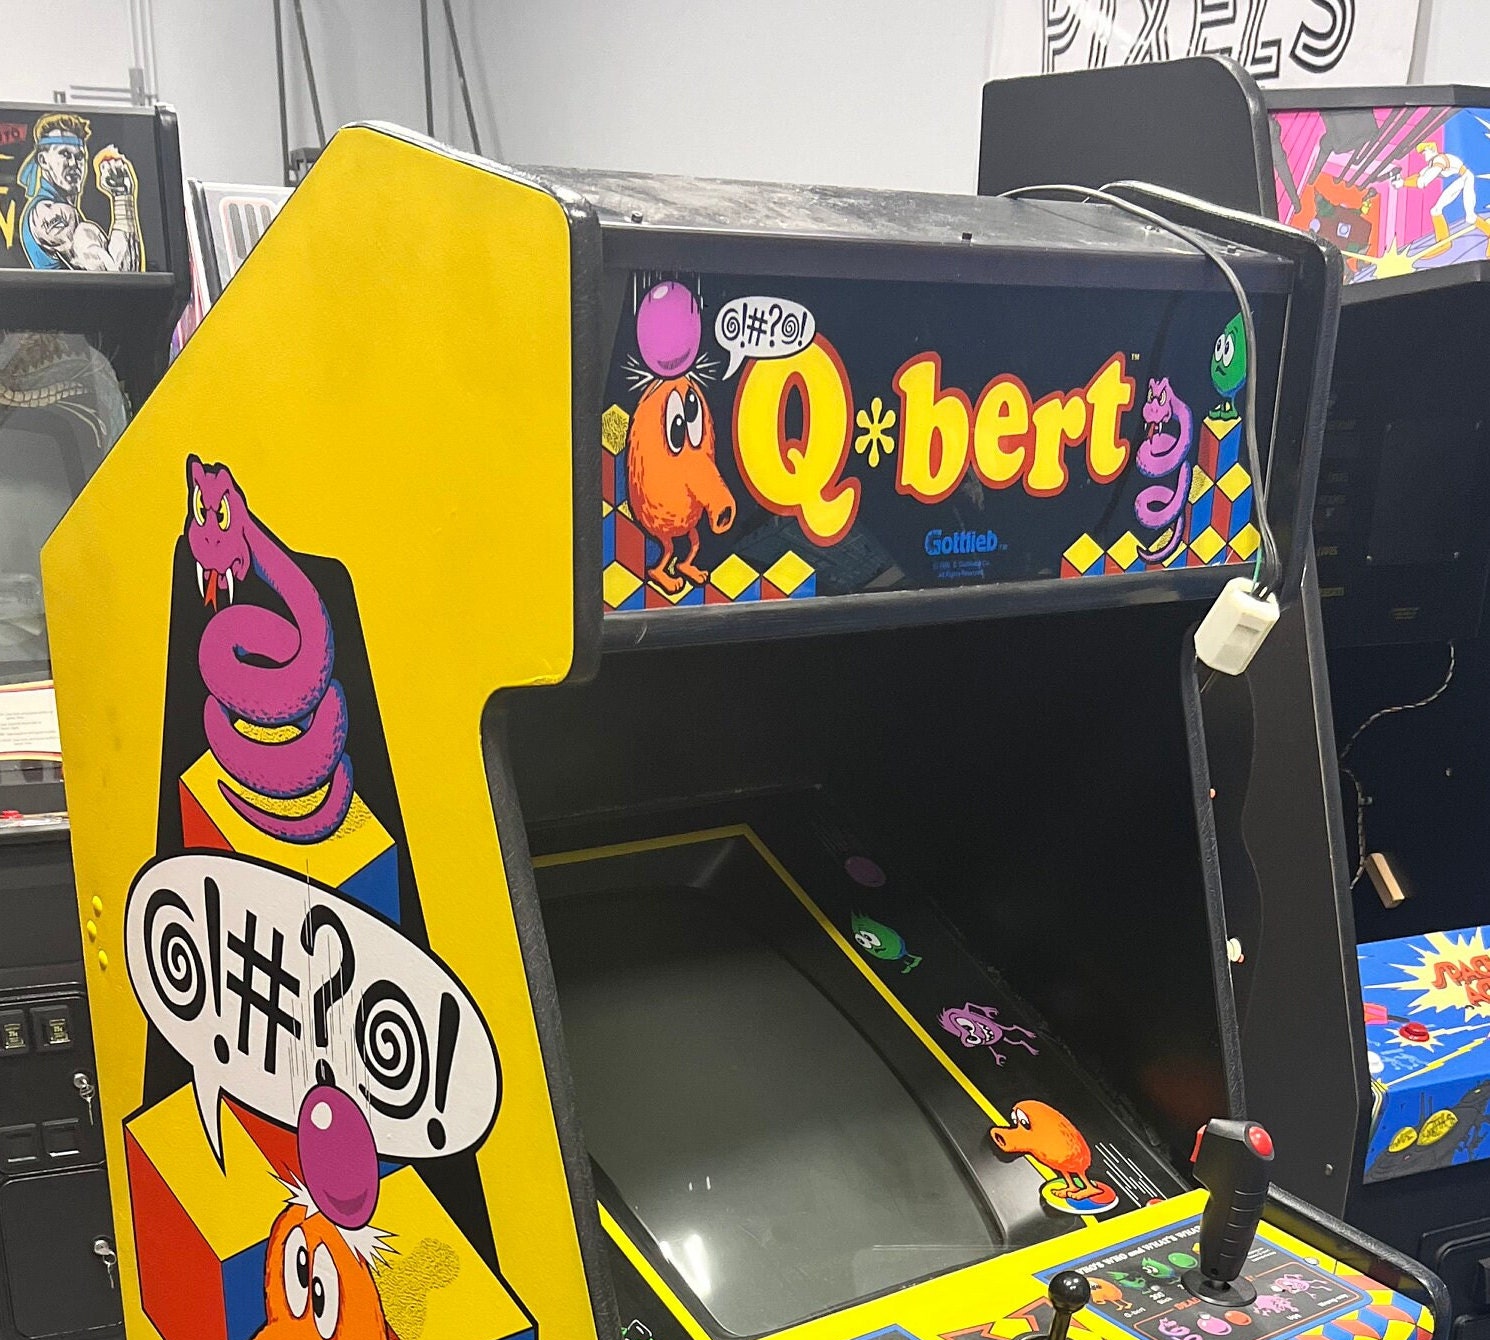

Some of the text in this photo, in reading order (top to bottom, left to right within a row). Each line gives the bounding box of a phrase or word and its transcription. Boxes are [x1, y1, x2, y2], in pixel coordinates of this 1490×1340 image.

[924, 529, 998, 555] Gottlieb
[1432, 954, 1490, 989] SPAC
[1465, 979, 1490, 1006] AC
[1102, 1253, 1128, 1265] WHO
[1127, 1247, 1146, 1257] and
[1142, 1235, 1178, 1251] WHAT'S
